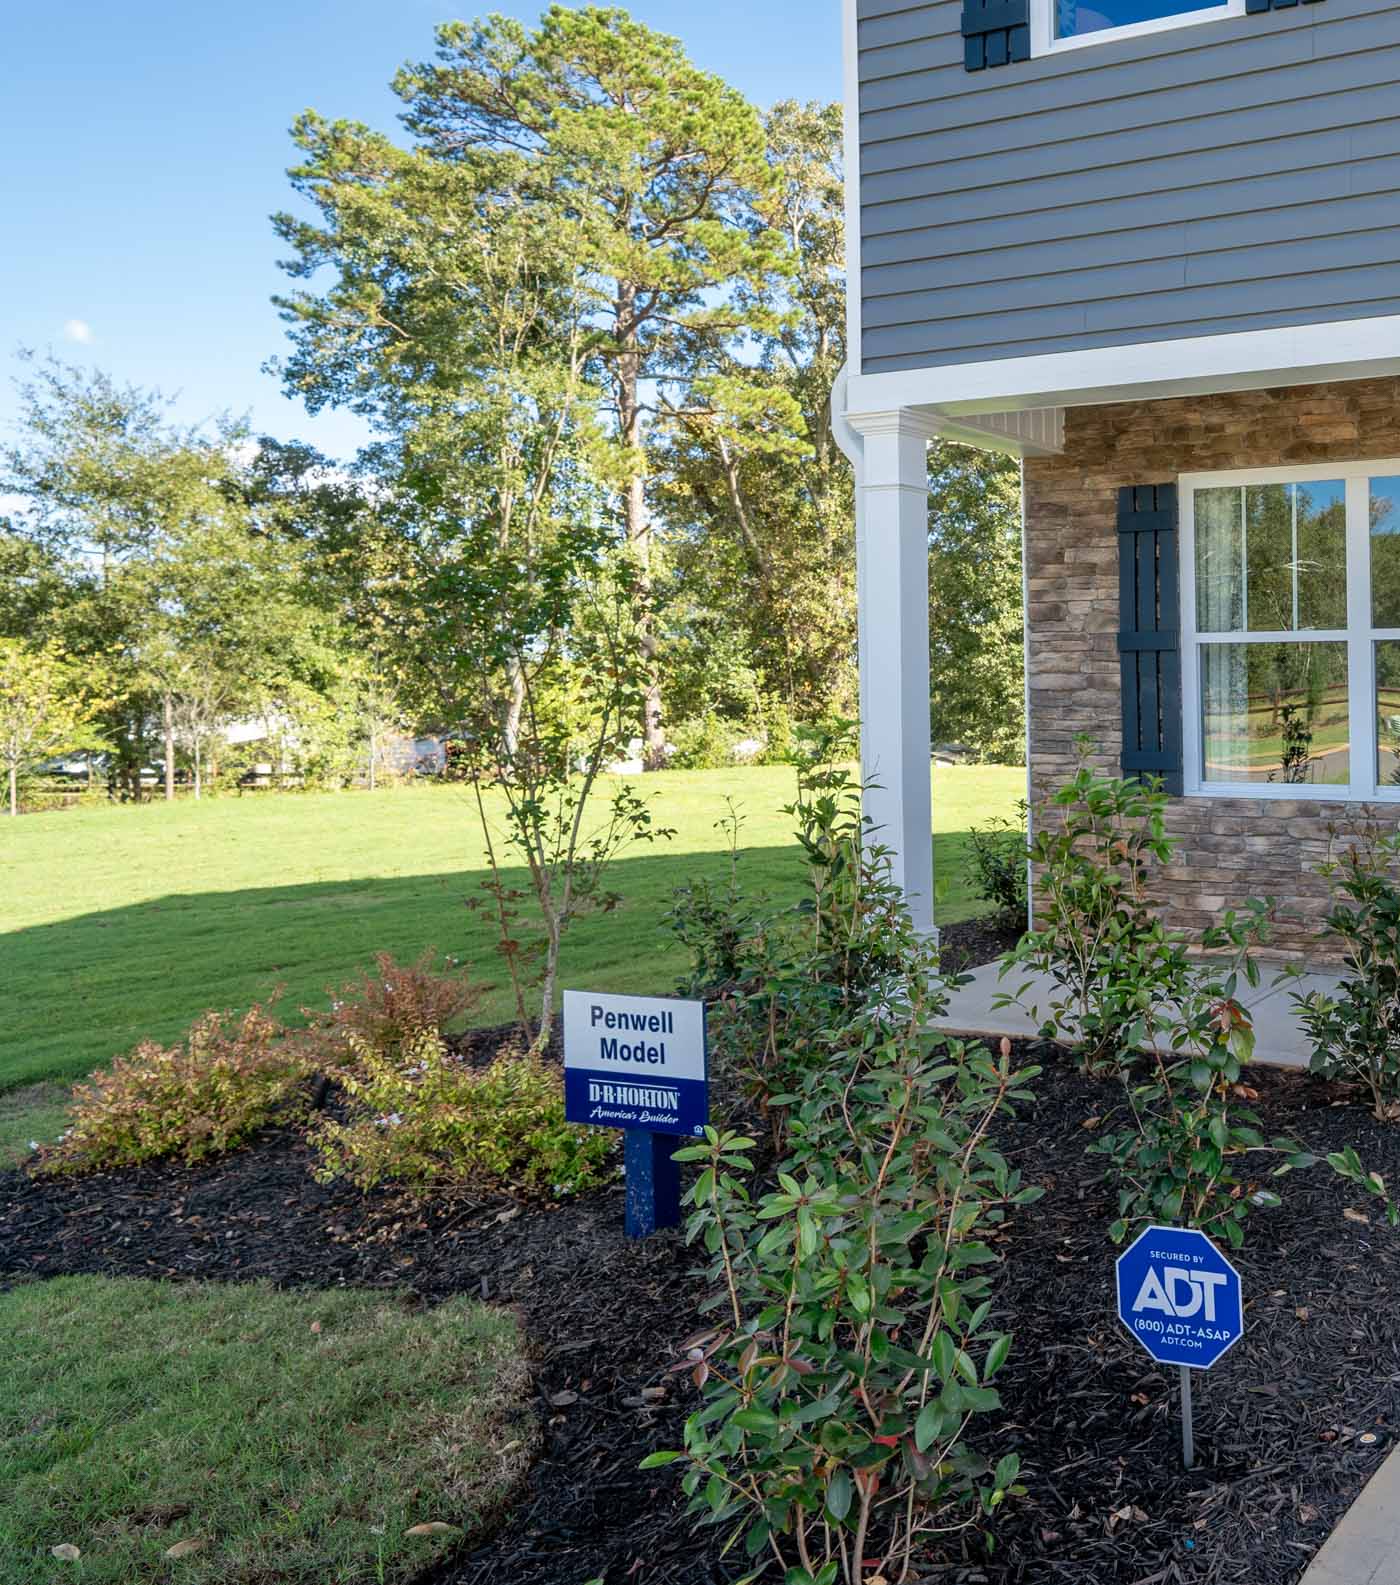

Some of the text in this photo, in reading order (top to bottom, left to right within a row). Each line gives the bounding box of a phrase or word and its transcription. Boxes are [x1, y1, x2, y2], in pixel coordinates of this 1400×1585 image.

[590, 1005, 673, 1034] Penwell
[600, 1038, 665, 1065] Model
[589, 1105, 679, 1125] America's Builder
[1150, 1250, 1204, 1264] SECURED BY
[1131, 1265, 1228, 1322] ADT
[1134, 1318, 1231, 1342] (800) ADT-ASAP
[1160, 1336, 1203, 1349] ADT.COM
